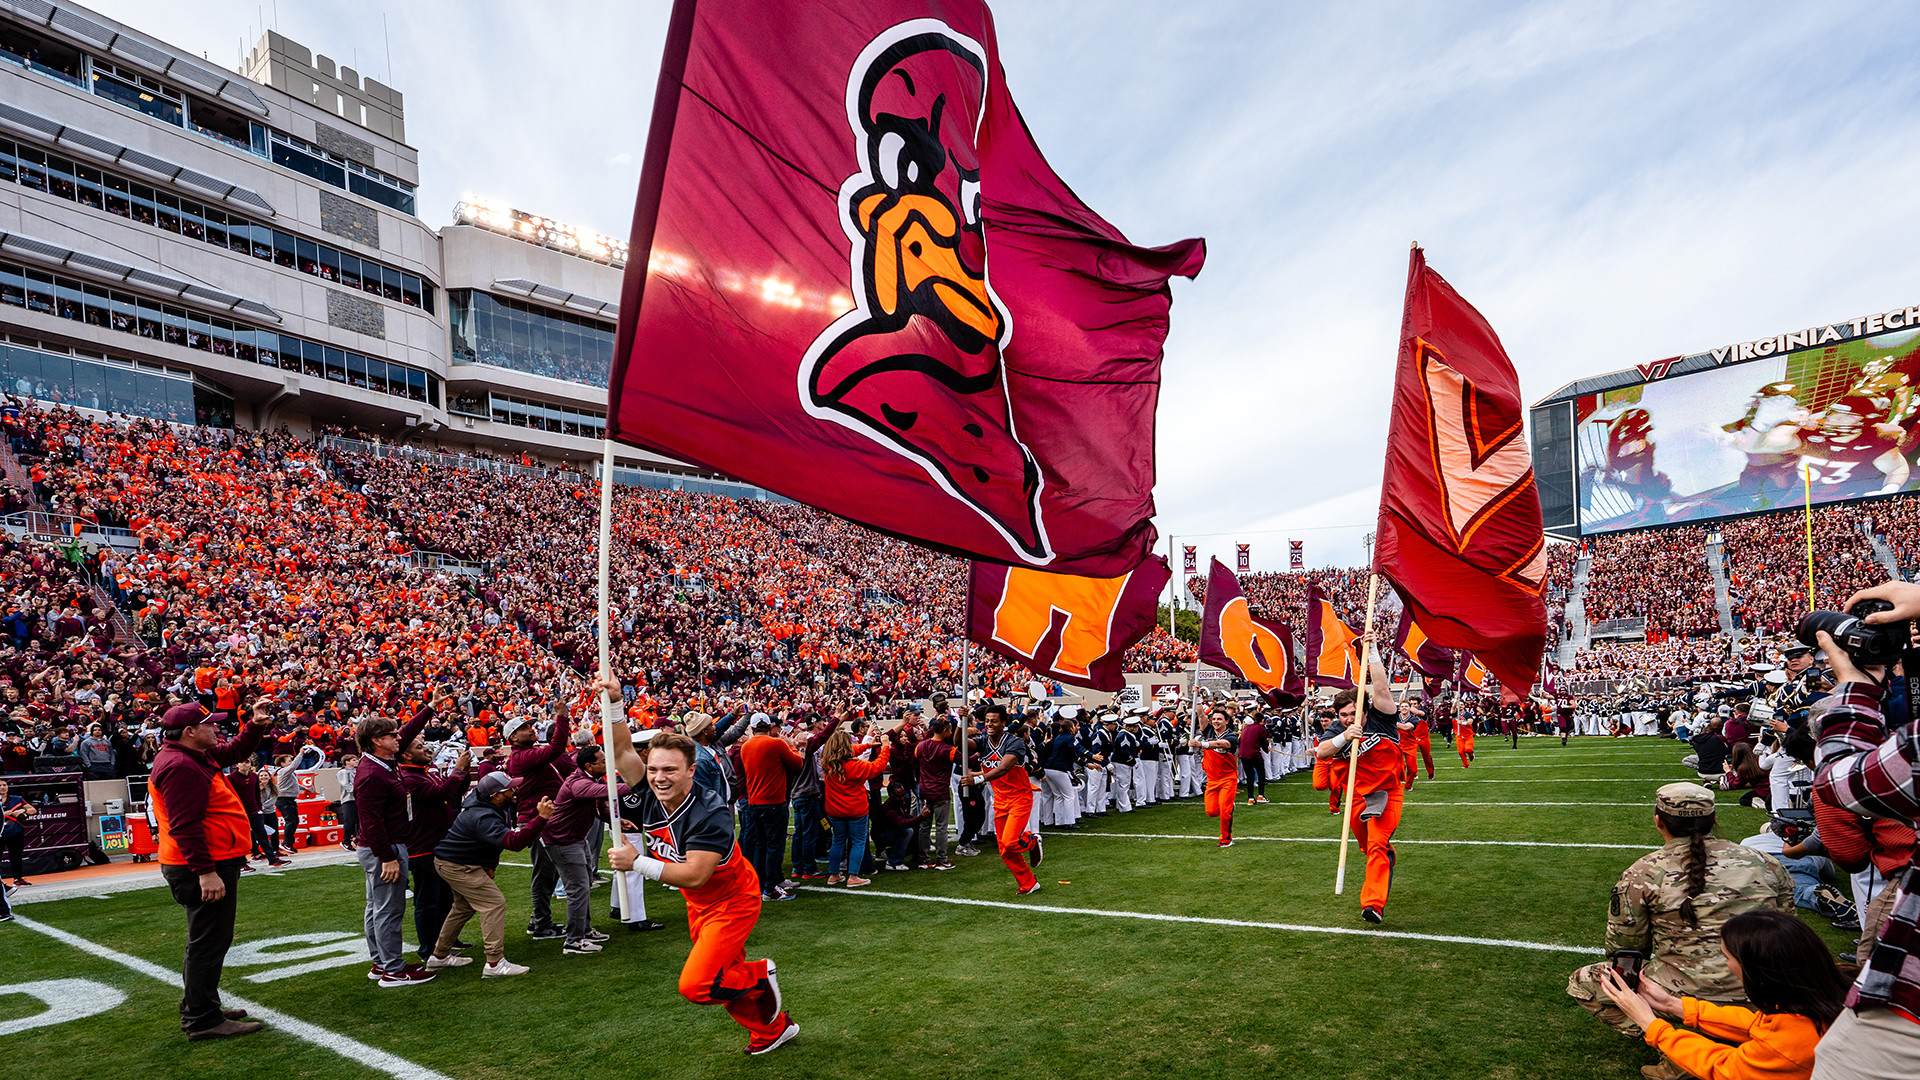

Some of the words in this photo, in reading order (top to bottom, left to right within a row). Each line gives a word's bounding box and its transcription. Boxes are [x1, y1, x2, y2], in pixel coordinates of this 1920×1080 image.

[1710, 324, 1843, 366] VIRGINIA
[1848, 304, 1920, 338] TECH
[1635, 354, 1685, 382] VT
[1796, 454, 1861, 485] 53
[1184, 558, 1196, 568] 84
[1239, 556, 1248, 566] 10
[1291, 553, 1302, 563] 25
[1156, 685, 1177, 695] ACC
[1909, 676, 1920, 695] EOS
[302, 777, 313, 787] G
[326, 831, 339, 842] G
[105, 838, 126, 850] TOY
